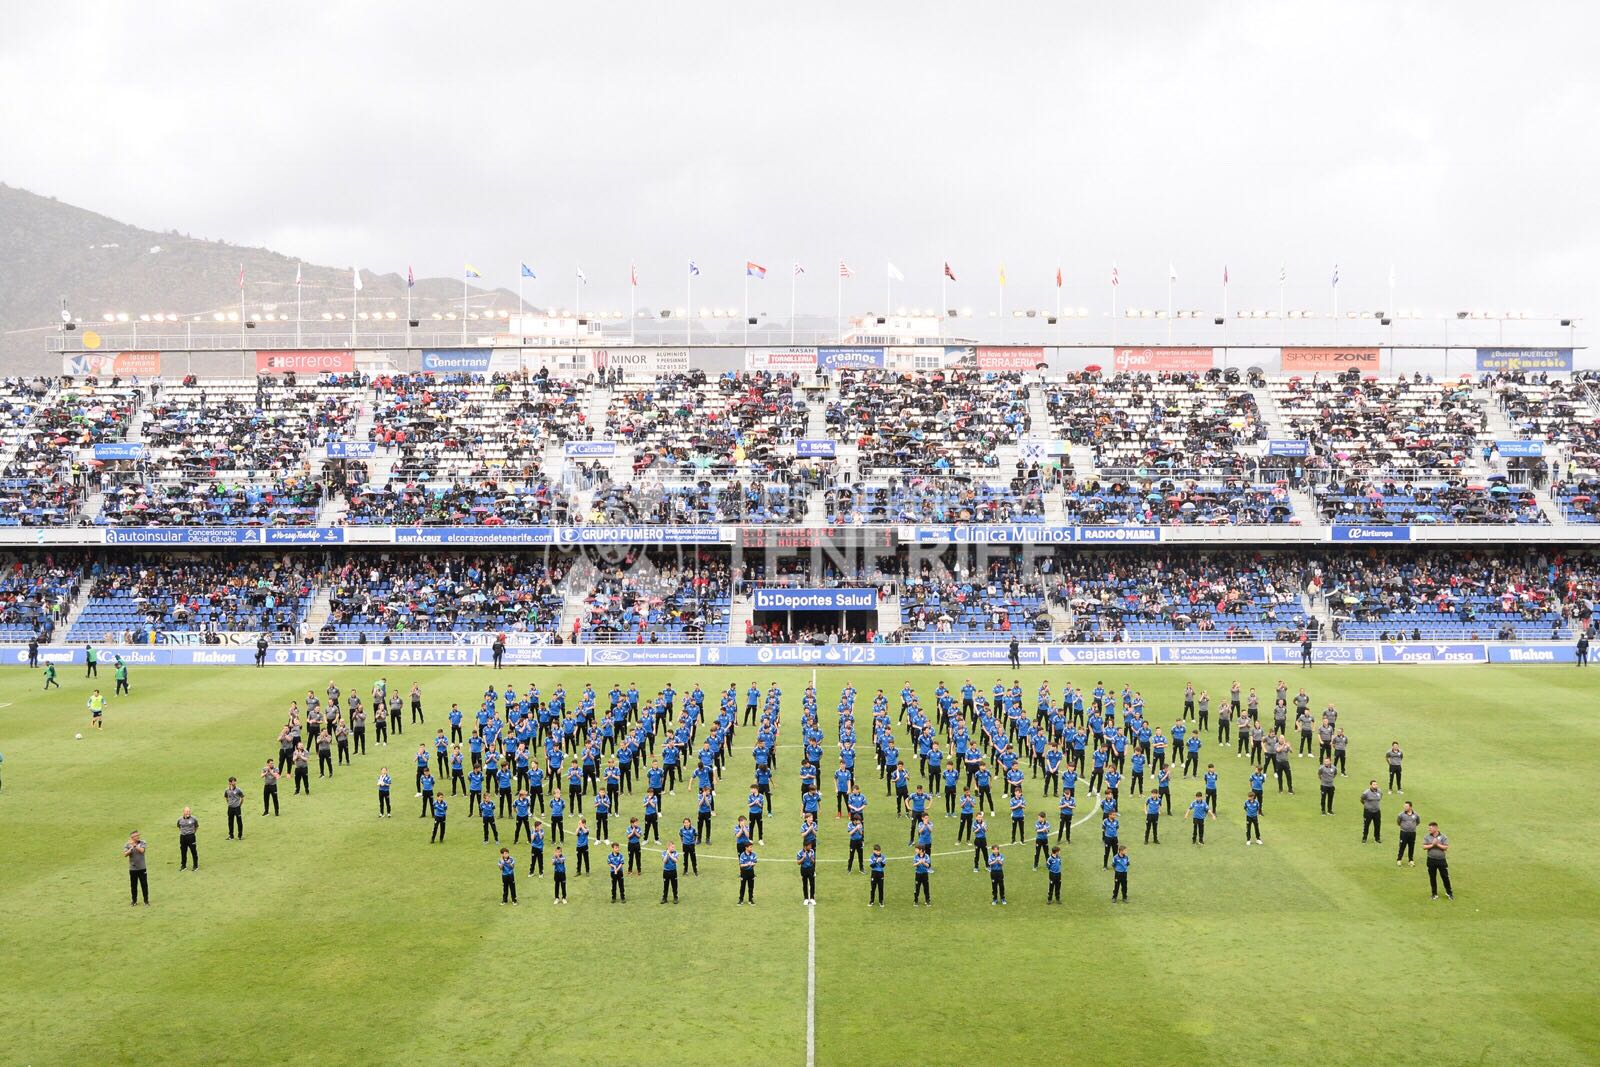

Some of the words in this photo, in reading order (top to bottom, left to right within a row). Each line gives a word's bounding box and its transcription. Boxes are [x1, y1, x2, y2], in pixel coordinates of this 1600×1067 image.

[428, 357, 488, 368] Tenertrans
[612, 354, 647, 364] MINOR
[826, 352, 875, 364] creamos
[119, 531, 183, 541] autoinsular
[447, 533, 551, 542] elcorazondetenerife.com
[581, 529, 618, 540] GRUPO
[621, 529, 664, 540] FUMERO
[780, 528, 834, 537] TENERIFE
[954, 526, 1007, 541] Clínica
[1012, 526, 1071, 541] Muiños
[1085, 530, 1116, 538] RADIO
[1126, 530, 1155, 539] MARCA
[779, 538, 820, 547] HUESCA
[885, 538, 891, 547] 1
[775, 594, 832, 608] Deportes
[836, 594, 871, 606] Salud
[103, 651, 156, 662] CaxaBank
[193, 652, 236, 662] Mahou
[292, 650, 347, 661] TIRSO
[389, 650, 467, 660] SABATER
[600, 649, 624, 660] Ford
[776, 647, 821, 661] LaLiga
[943, 649, 964, 659] Ford
[1077, 648, 1140, 660] cajasiete
[1283, 647, 1323, 660] Tenife
[1509, 649, 1553, 660] Mahou
